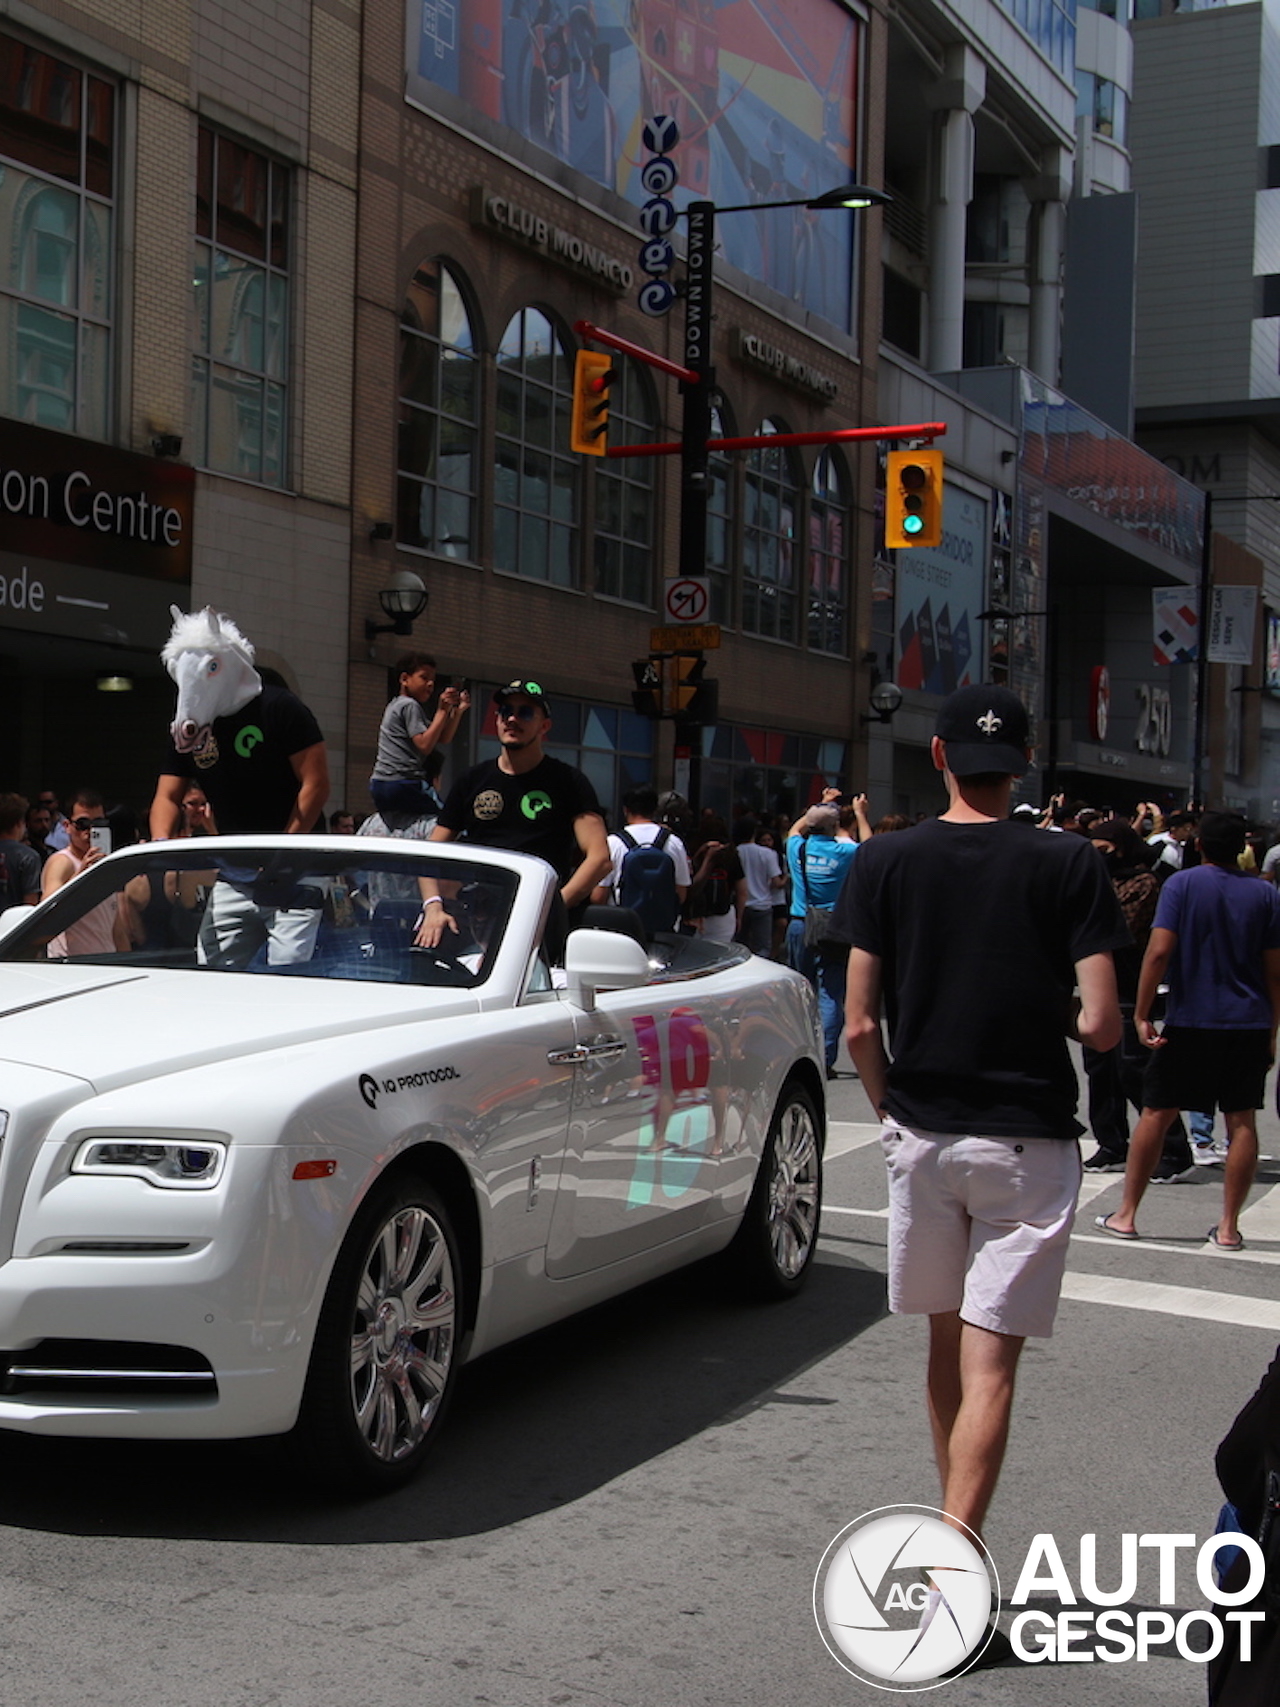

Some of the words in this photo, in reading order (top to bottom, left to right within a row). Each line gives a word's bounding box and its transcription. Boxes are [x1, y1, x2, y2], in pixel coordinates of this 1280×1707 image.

[491, 196, 548, 244] CLUB
[554, 227, 634, 290] MONACO
[639, 115, 677, 317] Yonge
[686, 212, 705, 365] DOWNTOWN
[745, 335, 784, 371] CLUB
[63, 470, 183, 547] Centre
[397, 1066, 461, 1091] PROTOCOL
